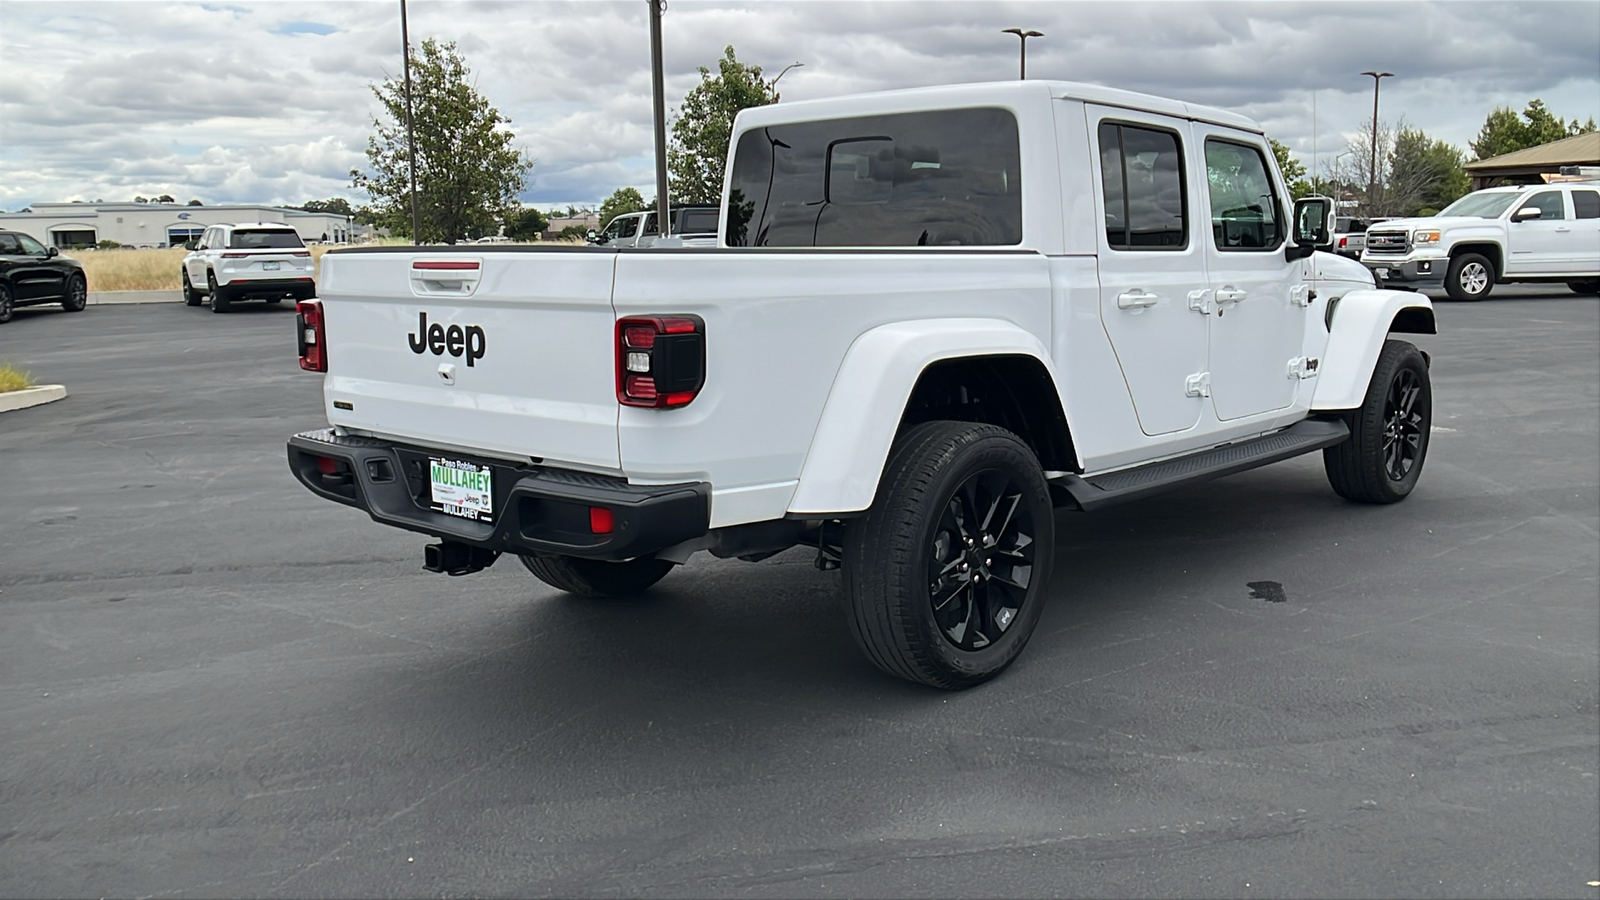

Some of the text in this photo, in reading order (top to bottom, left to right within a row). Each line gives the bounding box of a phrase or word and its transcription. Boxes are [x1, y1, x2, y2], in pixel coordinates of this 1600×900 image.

[408, 312, 486, 367] Jeep
[441, 458, 477, 473] Paso Robles
[432, 465, 489, 493] MULLAHEY
[465, 493, 479, 505] Jeep
[443, 503, 479, 520] MULLAHEY
